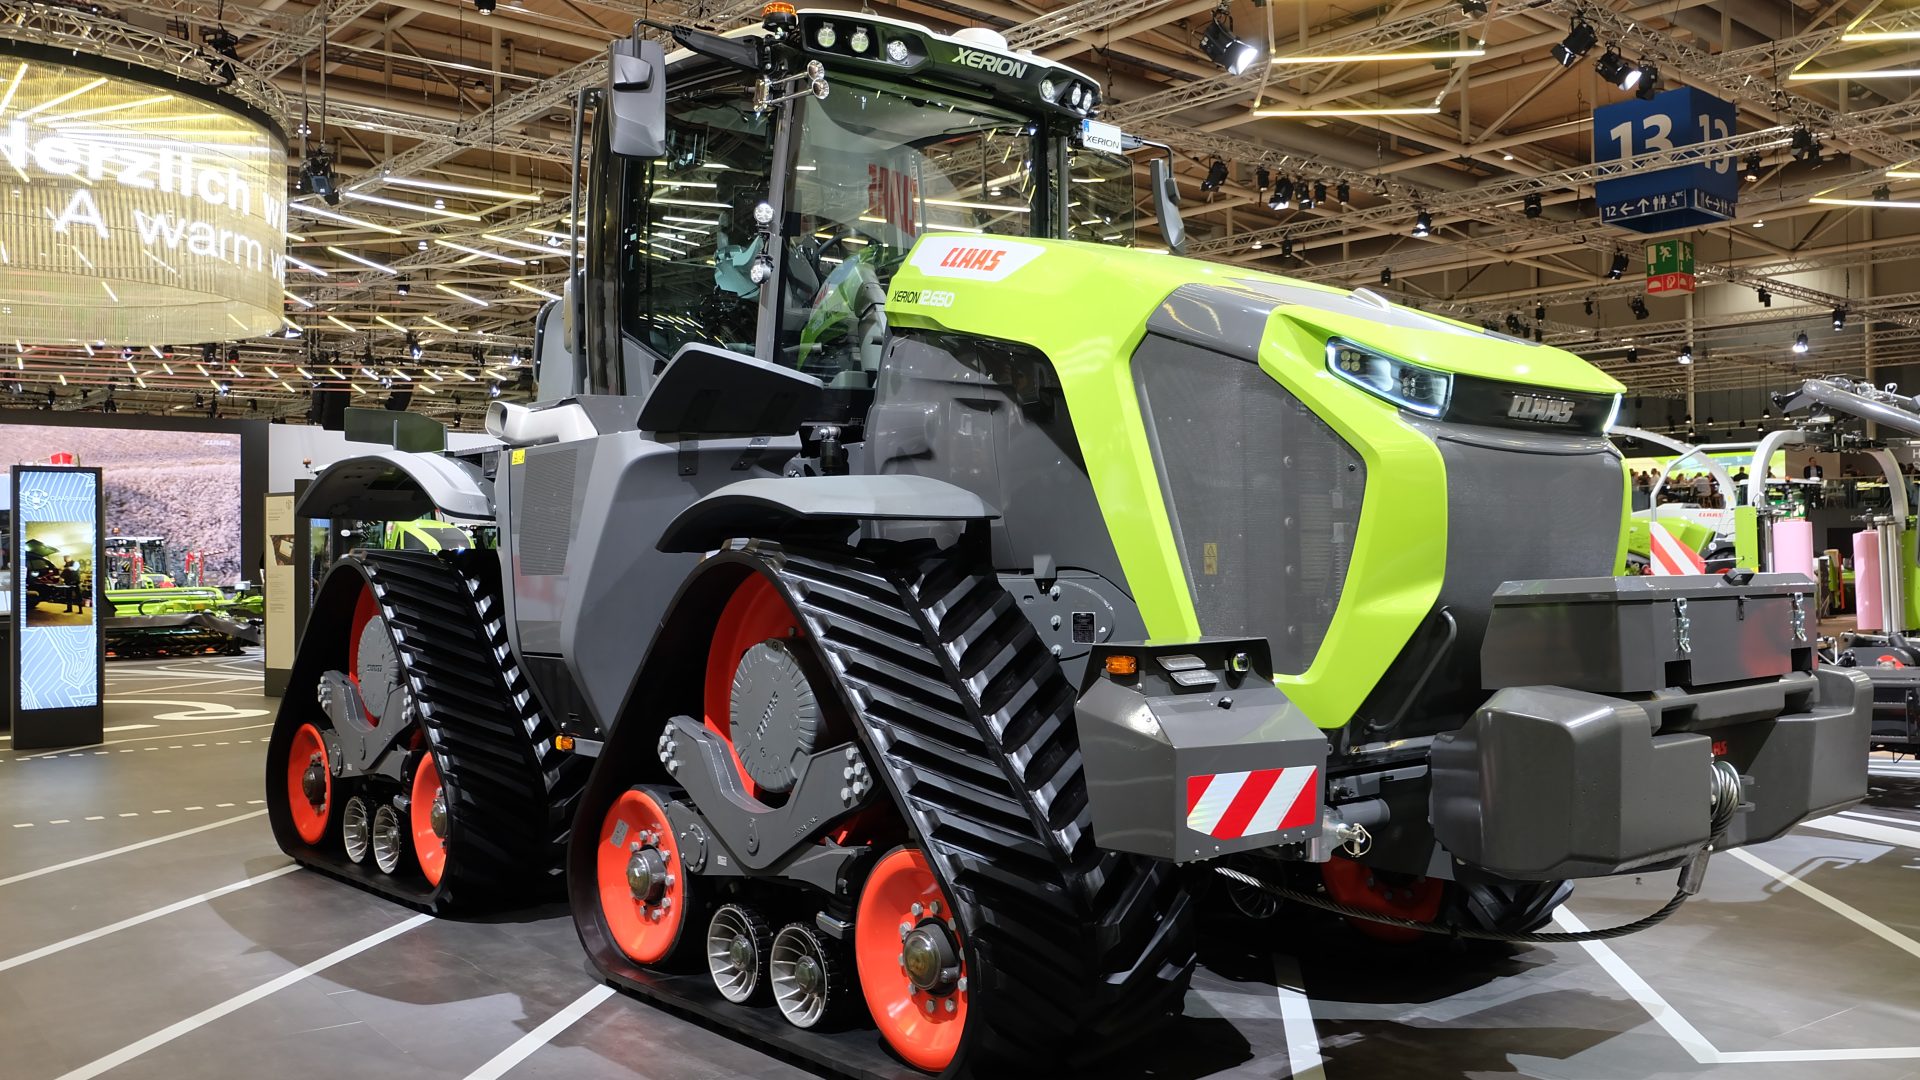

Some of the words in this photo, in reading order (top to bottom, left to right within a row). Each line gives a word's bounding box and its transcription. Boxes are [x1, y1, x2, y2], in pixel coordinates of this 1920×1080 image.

[952, 47, 1028, 79] XERION
[1086, 134, 1120, 149] XERION
[1610, 114, 1674, 172] 13
[1605, 206, 1617, 217] 12
[54, 188, 109, 239] A
[133, 208, 262, 272] warm
[941, 247, 1007, 272] CLAAS
[892, 290, 920, 304] XERION
[1508, 395, 1576, 423] CLAAS
